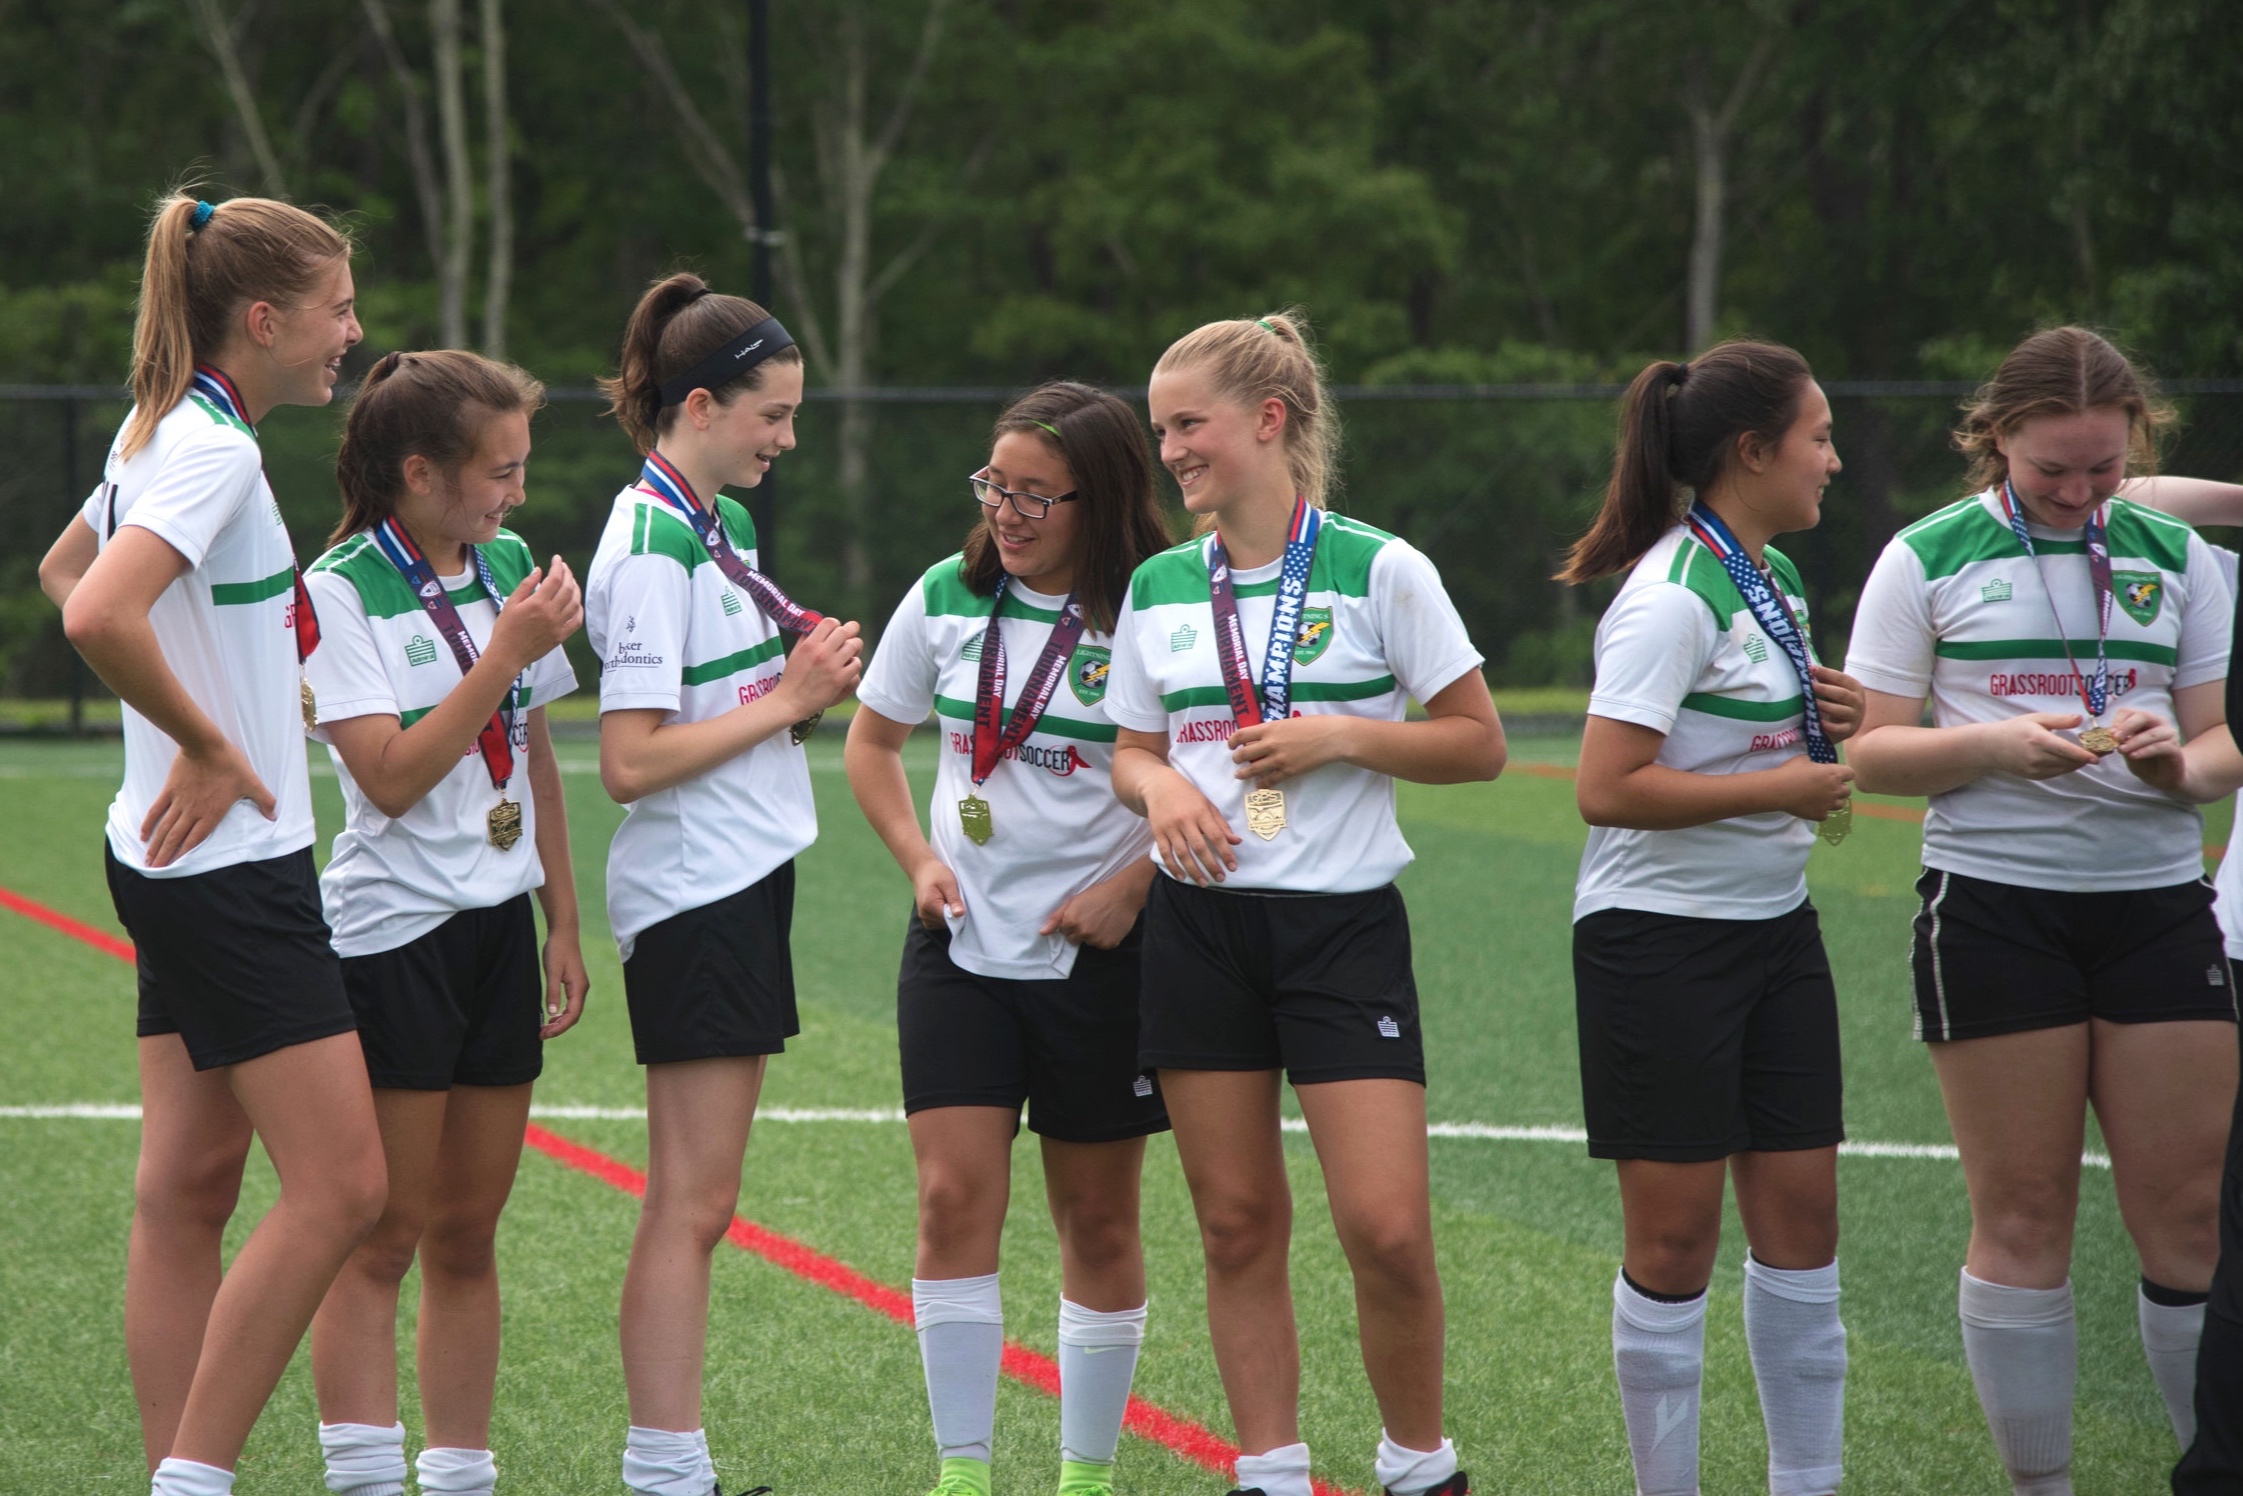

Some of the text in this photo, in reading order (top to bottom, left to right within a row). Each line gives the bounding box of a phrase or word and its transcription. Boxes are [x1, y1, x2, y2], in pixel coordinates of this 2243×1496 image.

[747, 570, 805, 617] MEMORIAL DAY
[977, 621, 997, 730] OURNAMENT
[993, 679, 1004, 698] DAY
[1030, 654, 1067, 720] MEMORIAL DAY
[1215, 607, 1250, 716] TOURNAMENT
[1228, 613, 1250, 681] MEMORIAL DAY
[1264, 577, 1302, 723] HAMPIONS
[1004, 641, 1064, 743] TOURNAMENT
